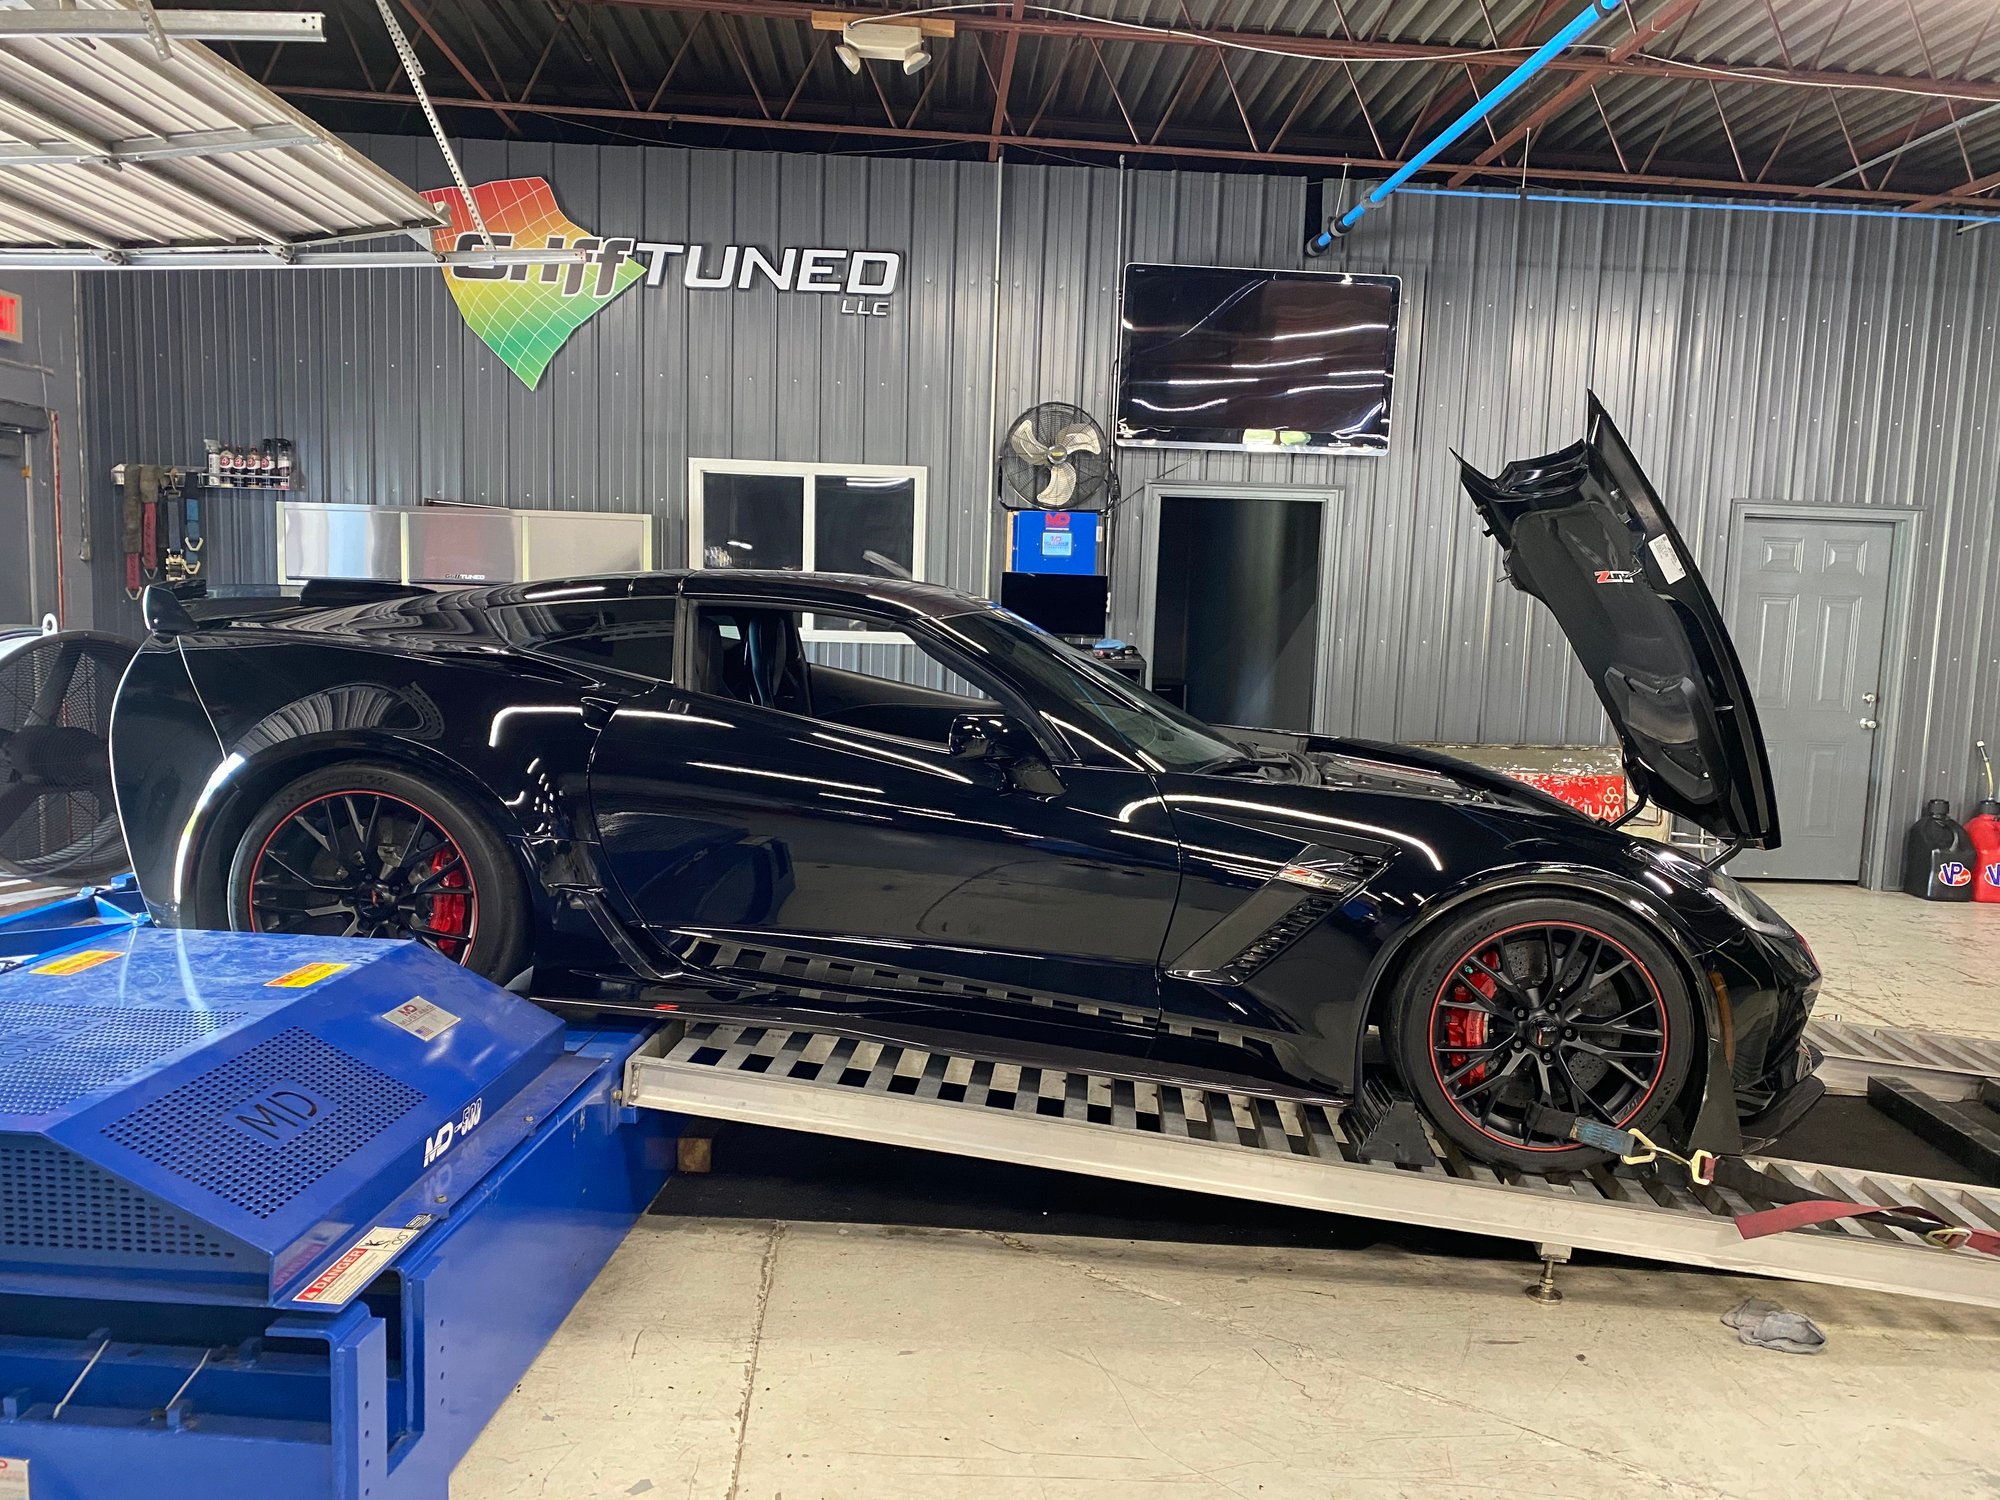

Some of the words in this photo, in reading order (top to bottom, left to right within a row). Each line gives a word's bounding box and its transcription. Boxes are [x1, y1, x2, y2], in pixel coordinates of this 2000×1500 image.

[841, 299, 889, 316] LLC
[1941, 862, 1963, 885] VP
[399, 1004, 435, 1026] MUSTANG
[235, 1091, 318, 1140] MD
[315, 1249, 364, 1290] DANGER
